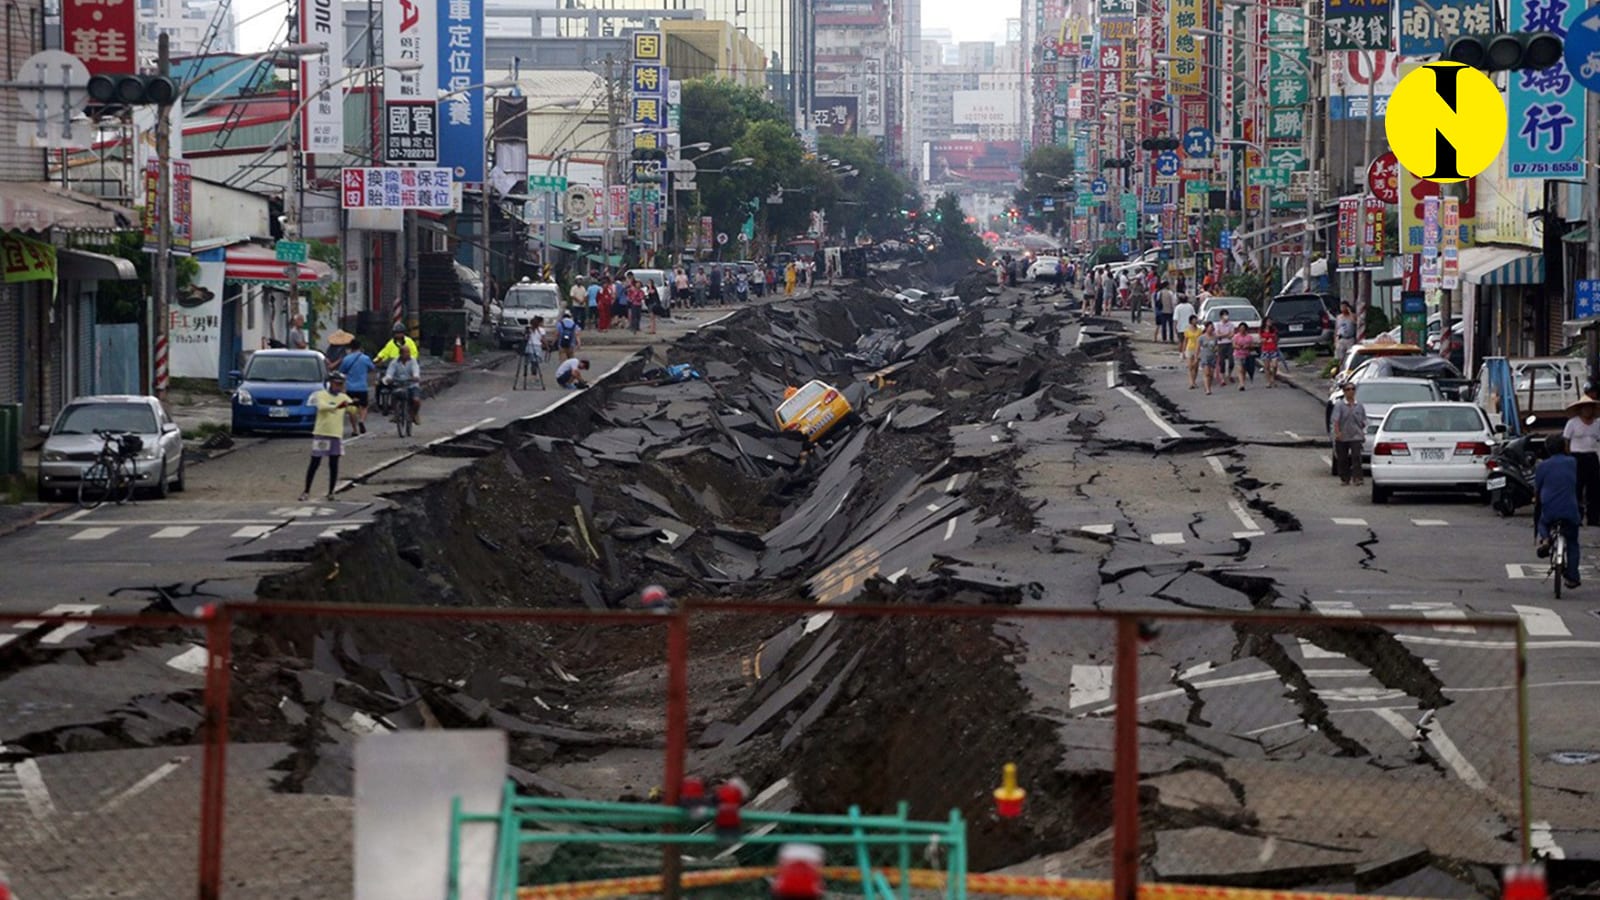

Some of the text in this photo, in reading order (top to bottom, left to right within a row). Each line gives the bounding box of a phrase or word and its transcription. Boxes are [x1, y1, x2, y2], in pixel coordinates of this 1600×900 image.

[1402, 3, 1490, 39] 頑皮族
[1520, 0, 1575, 151] 玻璃行
[389, 106, 433, 135] 國賓
[344, 170, 363, 206] 松田
[170, 310, 218, 331] 手工男鞋
